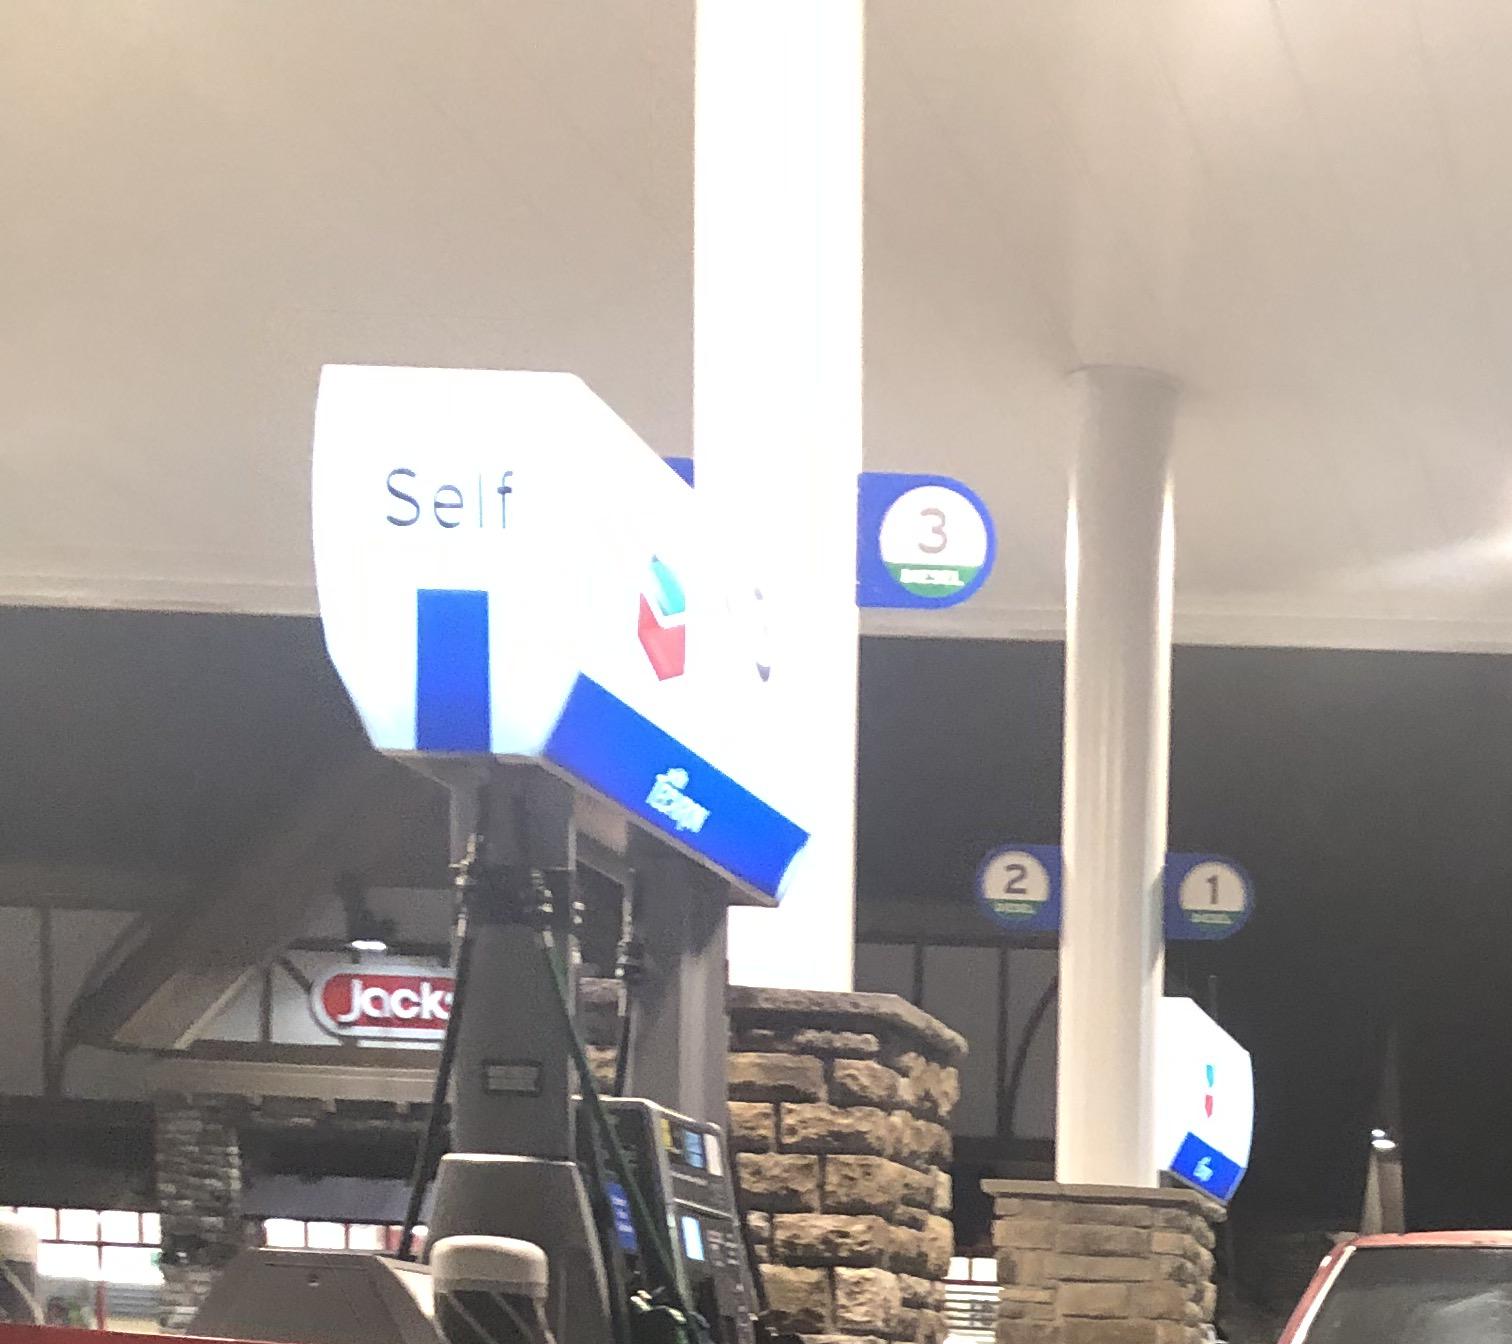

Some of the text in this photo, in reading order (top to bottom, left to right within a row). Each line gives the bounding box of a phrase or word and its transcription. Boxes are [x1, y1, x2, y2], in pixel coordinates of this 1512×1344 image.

[386, 467, 514, 529] Self
[918, 507, 948, 554] 3
[1003, 863, 1028, 895] 2
[1205, 874, 1221, 905] 1
[338, 978, 454, 1023] Jack
